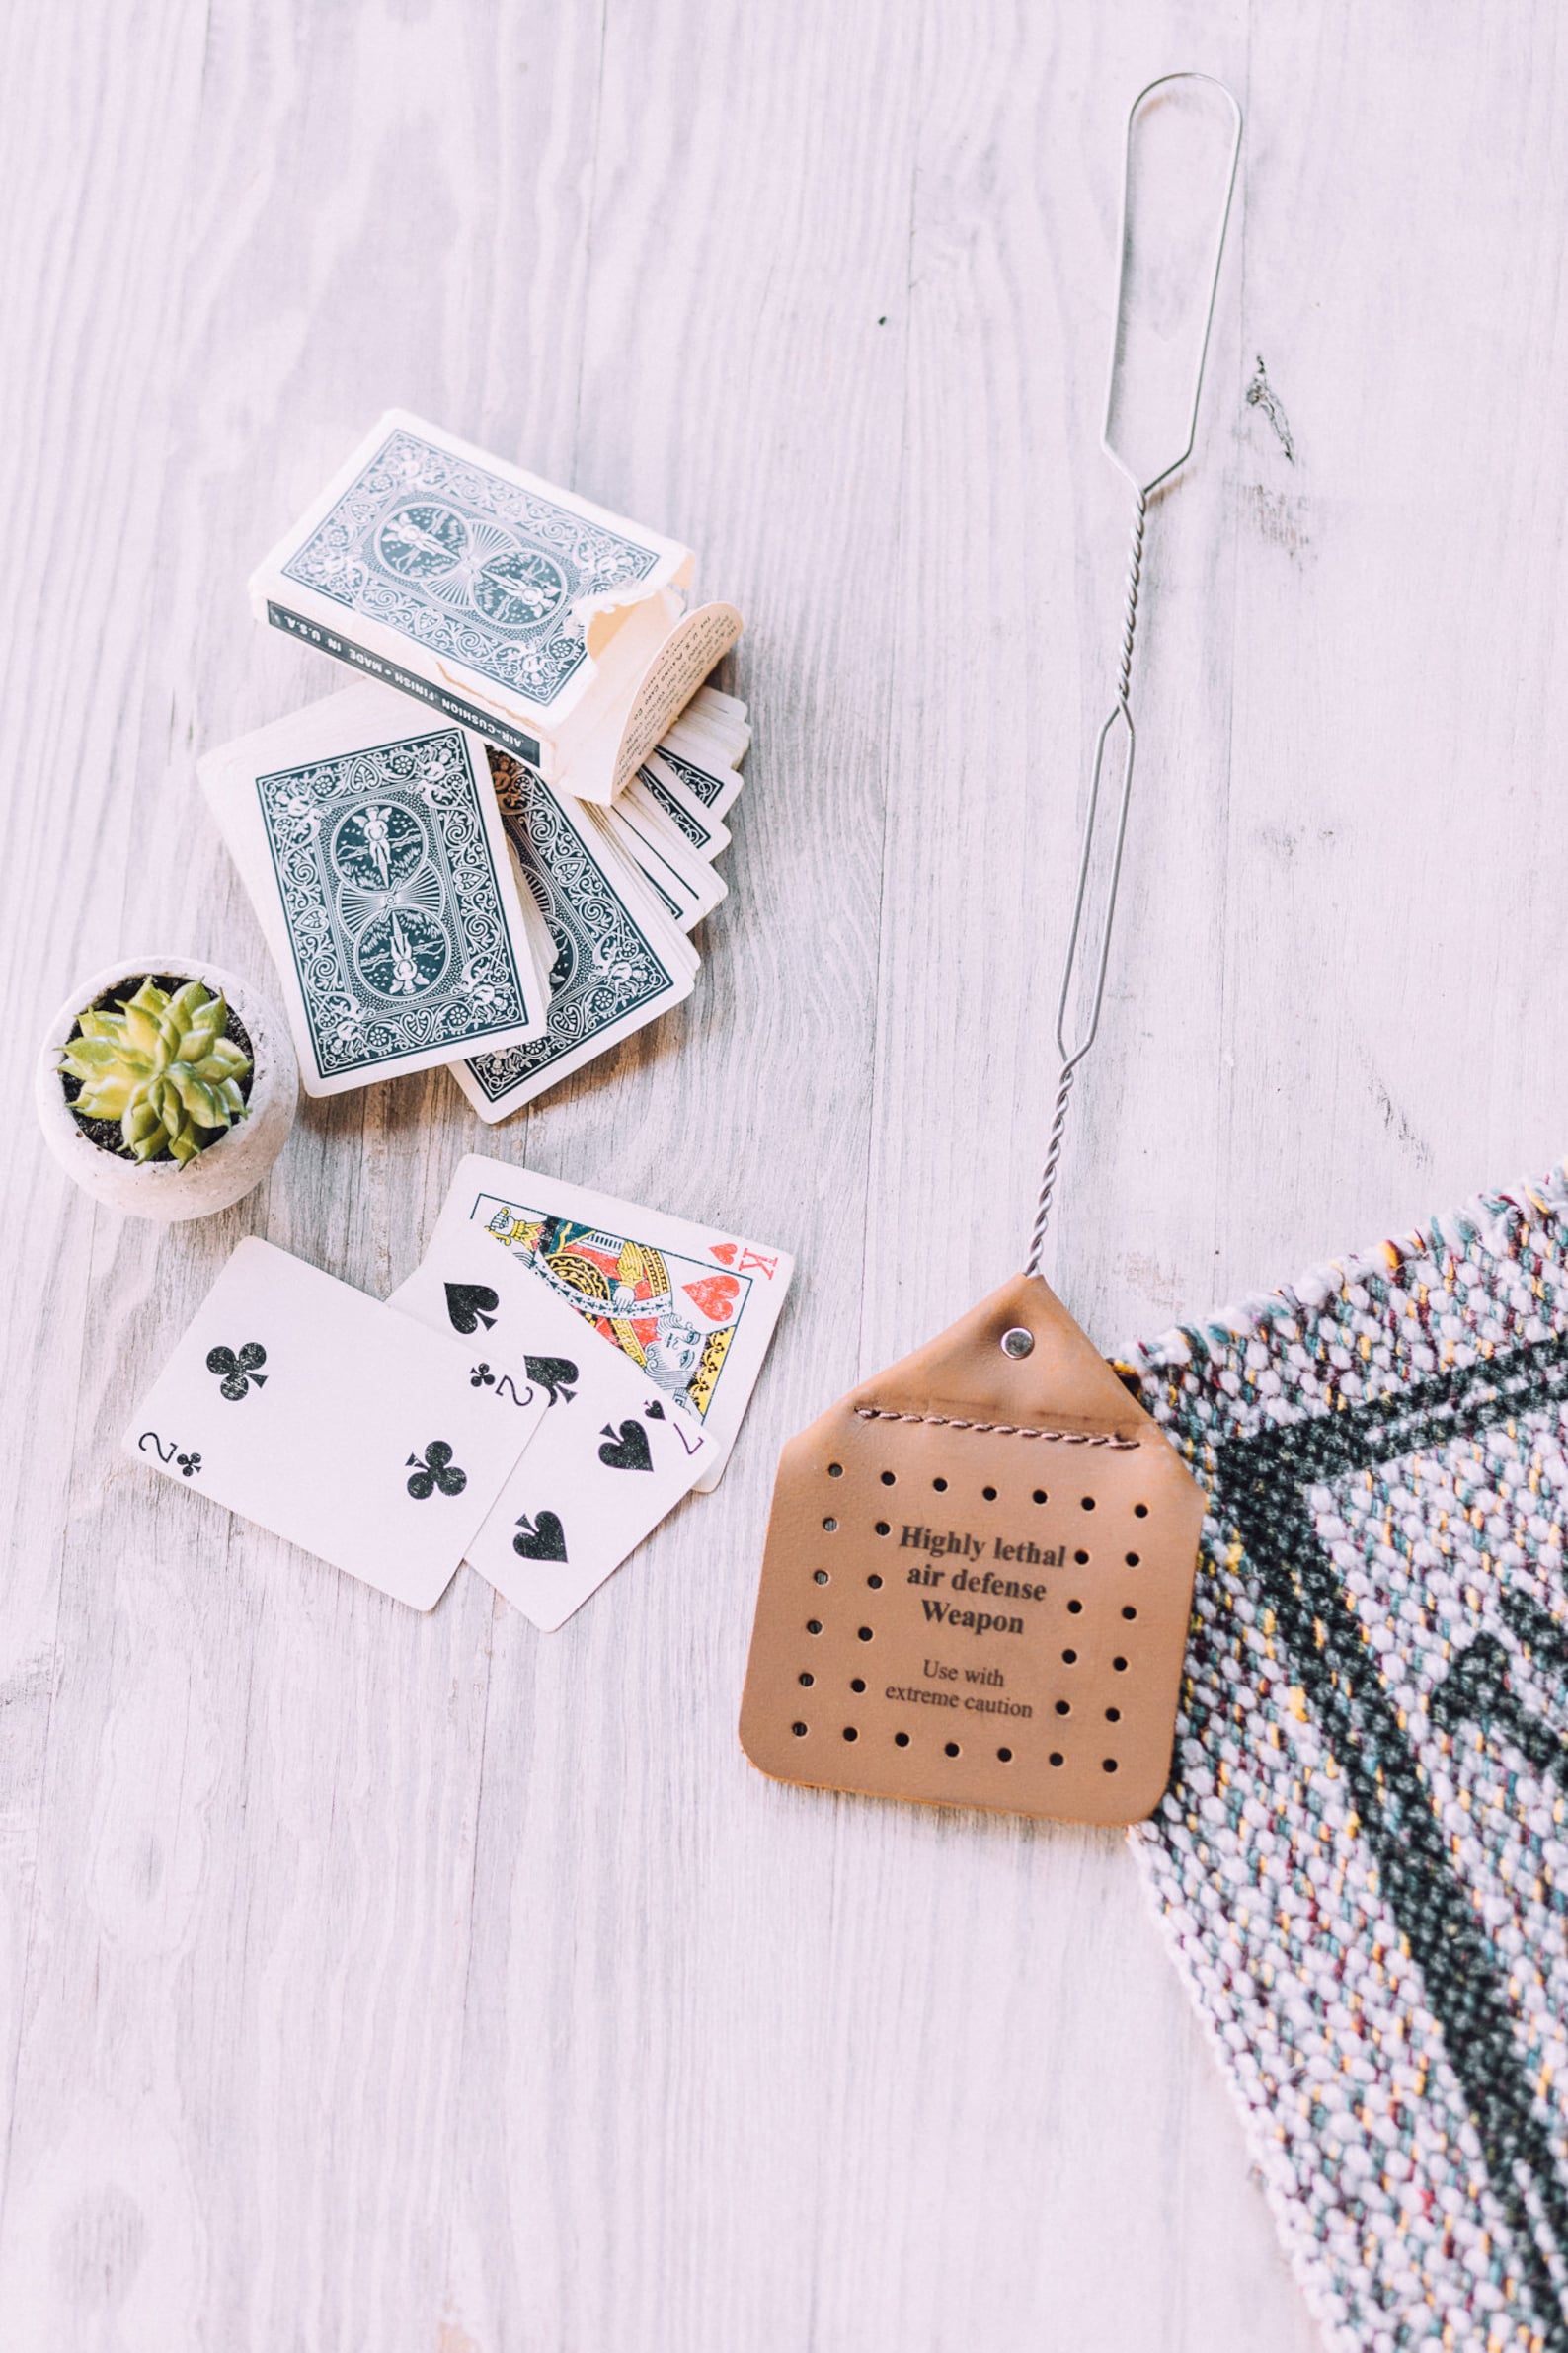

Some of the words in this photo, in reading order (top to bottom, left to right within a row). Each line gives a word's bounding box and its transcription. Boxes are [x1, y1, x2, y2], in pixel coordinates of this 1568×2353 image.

[328, 638, 342, 653] IN
[349, 648, 383, 677] MADE
[395, 673, 436, 702] FINISH
[442, 697, 521, 748] AIR-CUSHION
[741, 1247, 779, 1281] K
[494, 1376, 534, 1407] 2
[137, 1430, 178, 1464] 2
[672, 1420, 704, 1457] 7
[899, 1525, 985, 1562] Highly
[993, 1537, 1067, 1567] lethal
[906, 1564, 945, 1587] air
[950, 1569, 1047, 1602] defense
[921, 1599, 1025, 1635] Weapon
[923, 1659, 958, 1681] Use
[964, 1667, 1004, 1687] with
[885, 1686, 960, 1708] extreme
[964, 1697, 1034, 1719] caution
